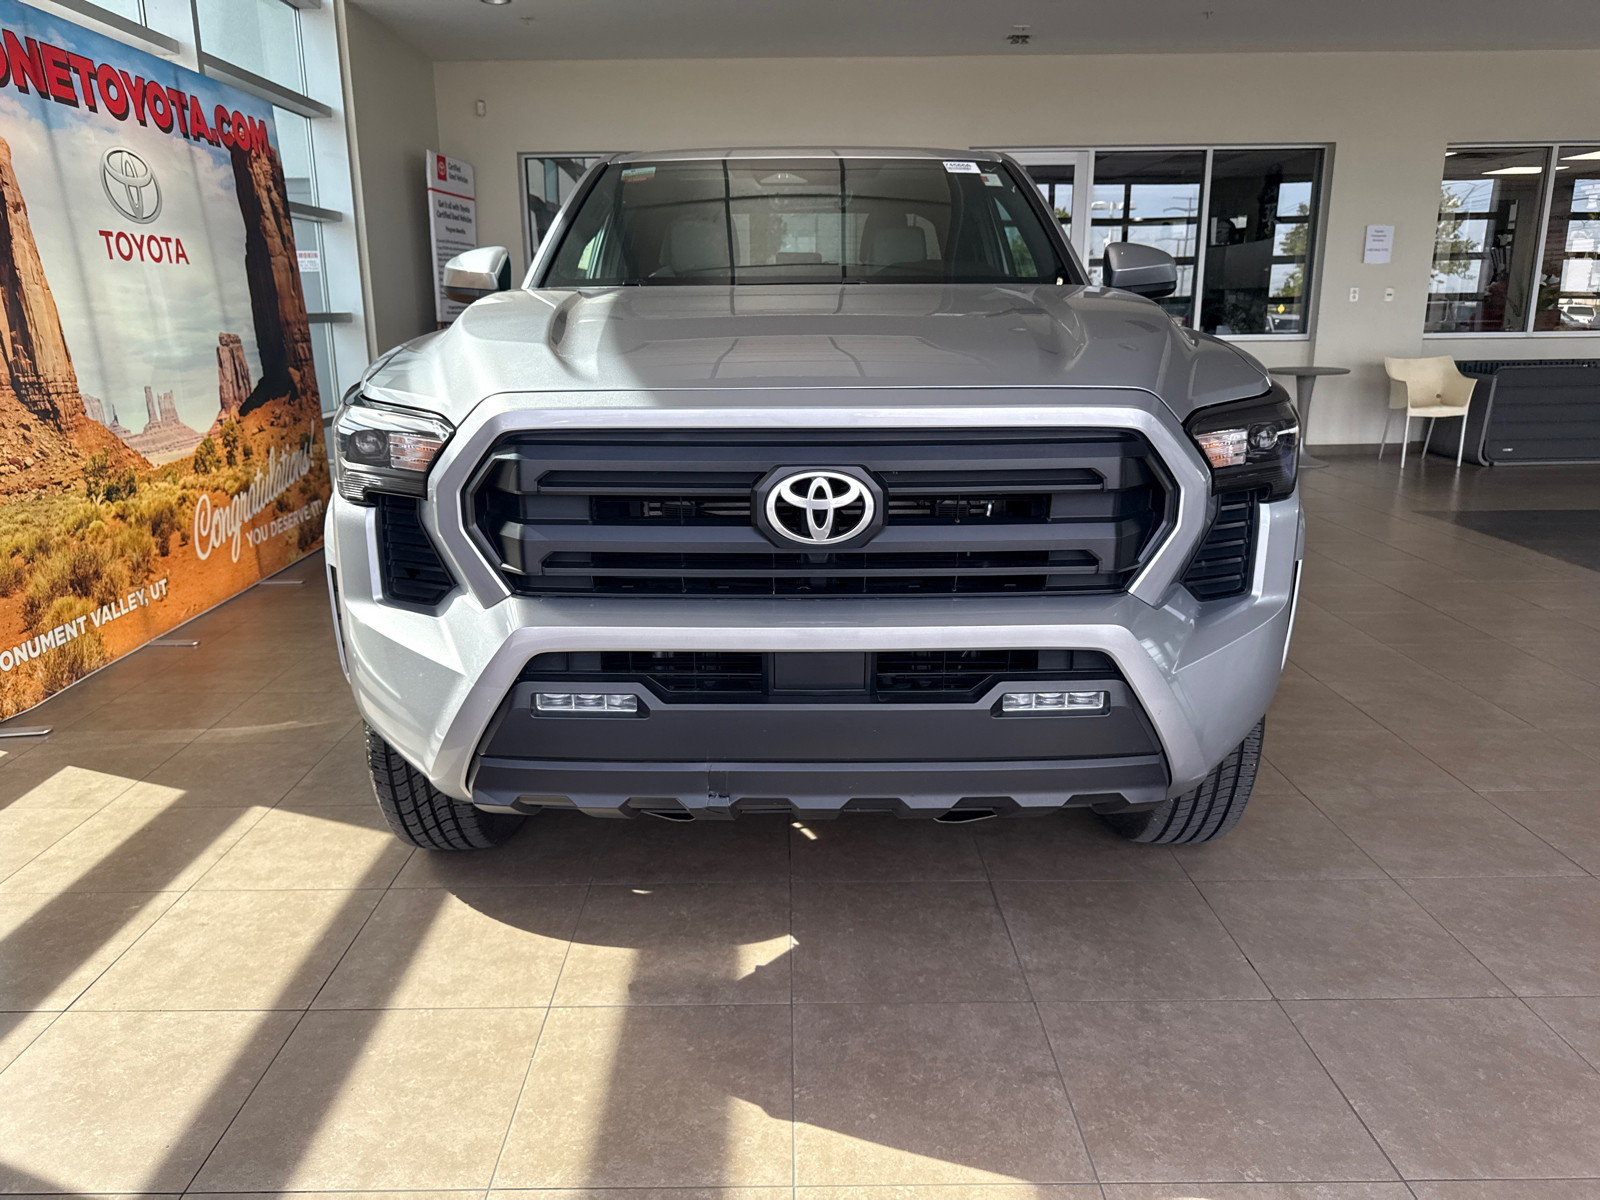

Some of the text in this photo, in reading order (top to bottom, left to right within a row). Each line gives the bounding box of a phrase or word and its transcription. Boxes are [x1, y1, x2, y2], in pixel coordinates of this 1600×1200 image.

[0, 28, 271, 158] NETOYOTA.COM
[98, 229, 190, 265] TOYOTA
[245, 498, 325, 548] YOU DESERVE IT!
[90, 588, 149, 628] VALLEY,
[149, 578, 168, 601] UT
